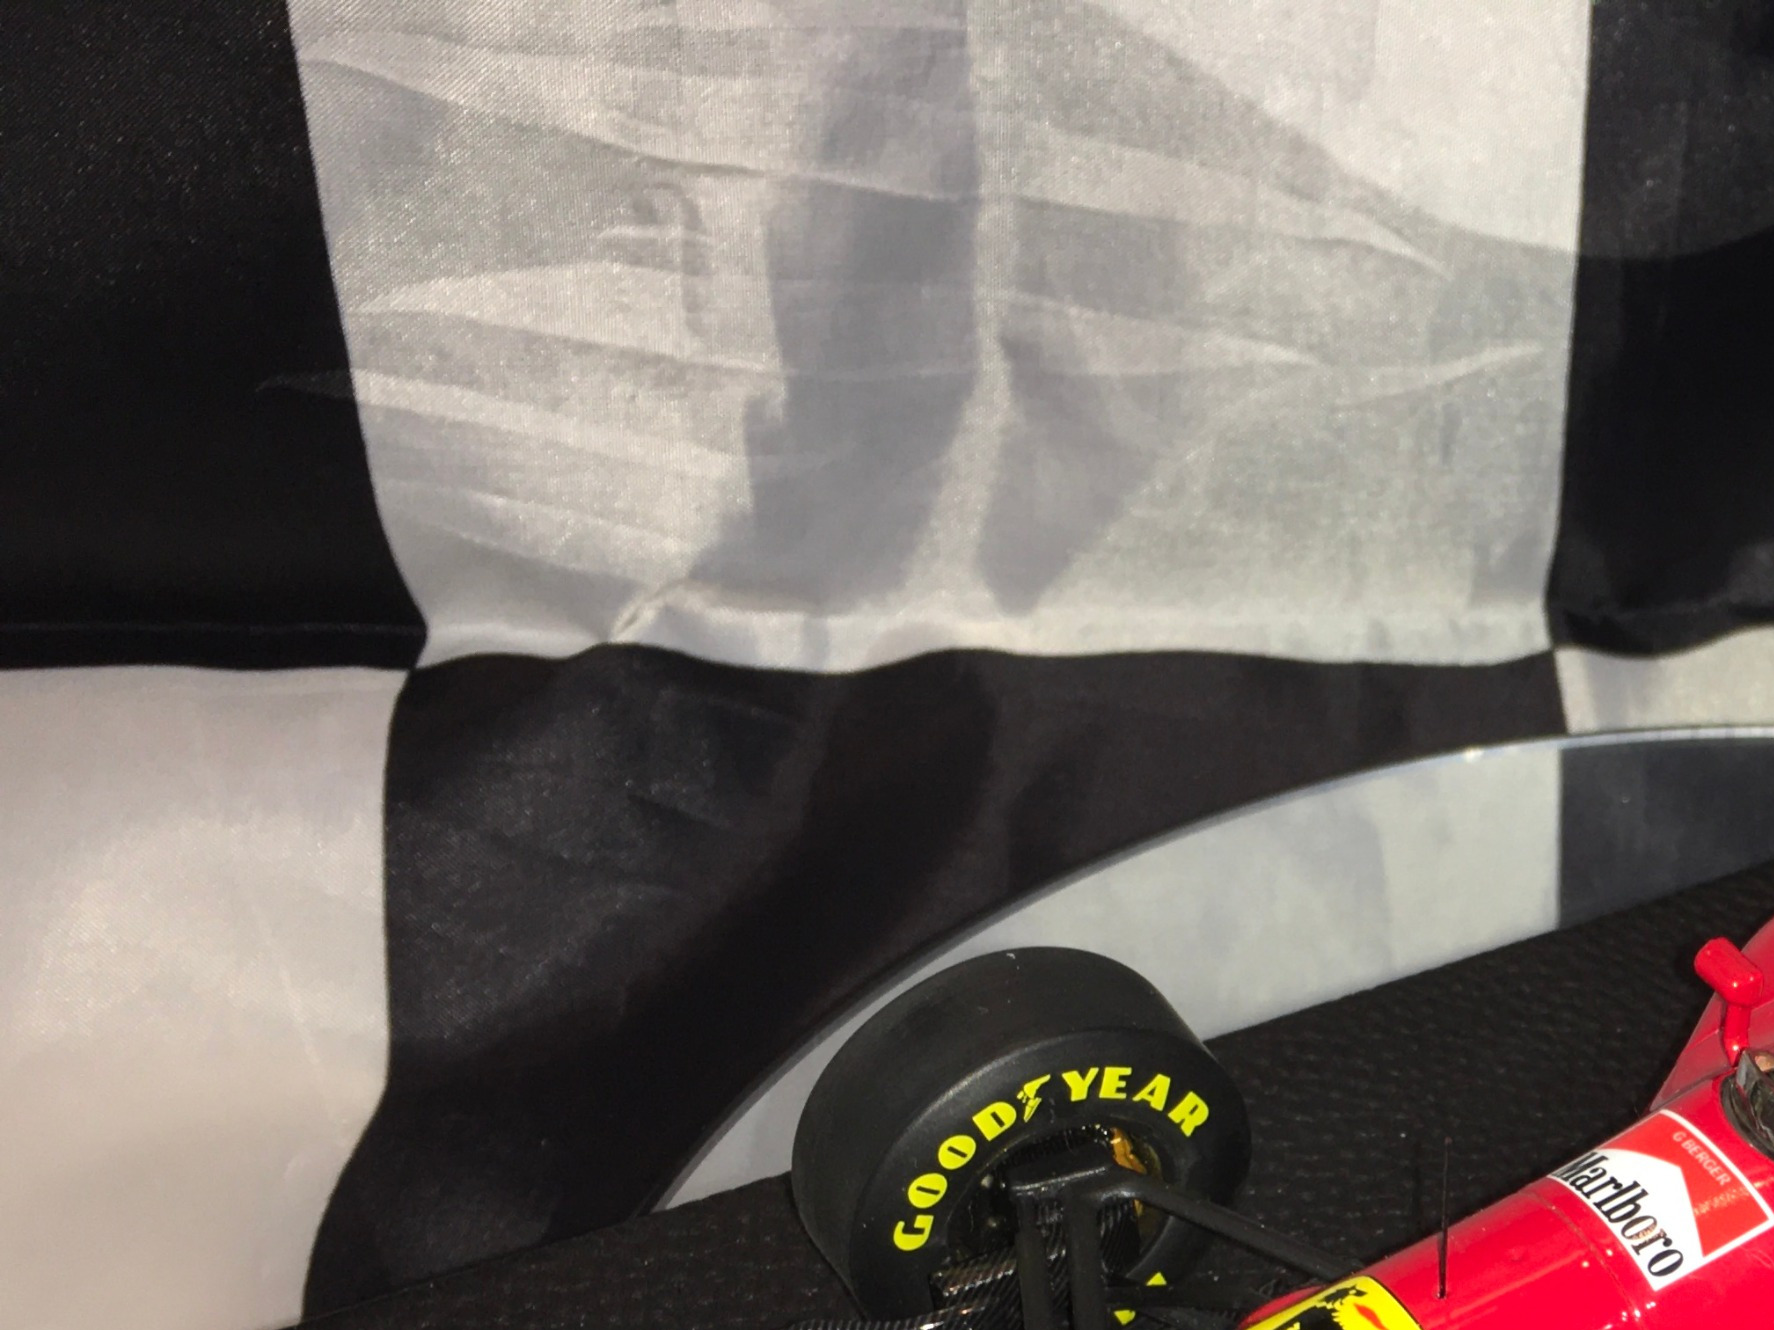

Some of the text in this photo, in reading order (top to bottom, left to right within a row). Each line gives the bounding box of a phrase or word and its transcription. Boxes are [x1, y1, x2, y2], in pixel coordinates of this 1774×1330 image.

[893, 1066, 1210, 1252] GOODYEAR
[1553, 1152, 1684, 1277] Marlboro
[1681, 1139, 1733, 1187] BERGER
